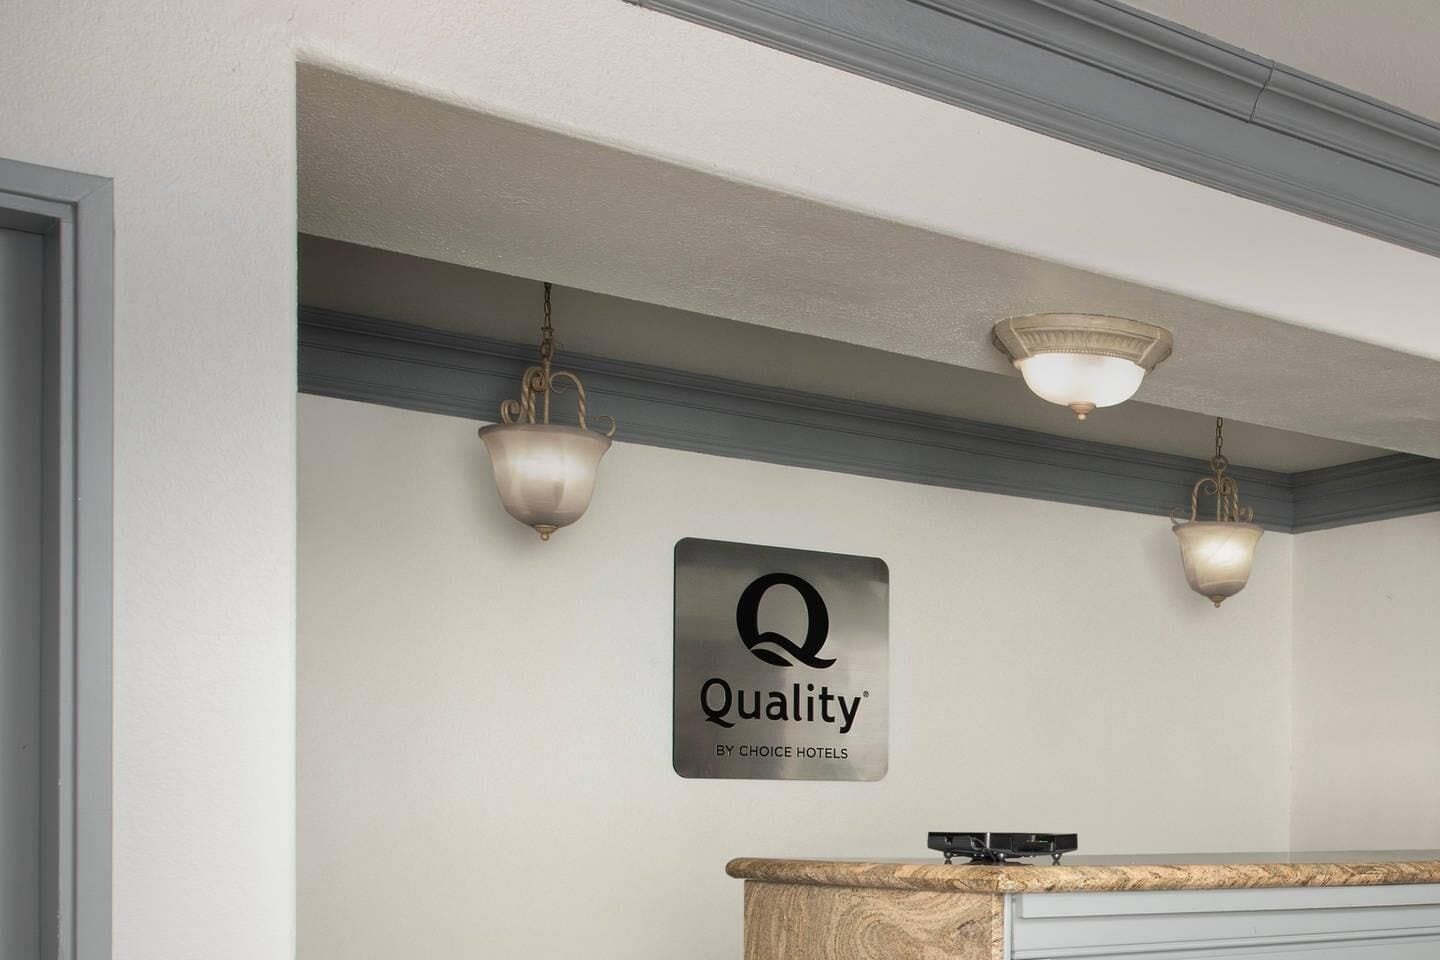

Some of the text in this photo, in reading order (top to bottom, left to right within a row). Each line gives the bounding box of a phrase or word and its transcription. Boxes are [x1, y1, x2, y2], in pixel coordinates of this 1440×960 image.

[736, 572, 837, 669] Q
[700, 677, 861, 734] Quality
[716, 744, 848, 759] BY CHOICE HOTELS
